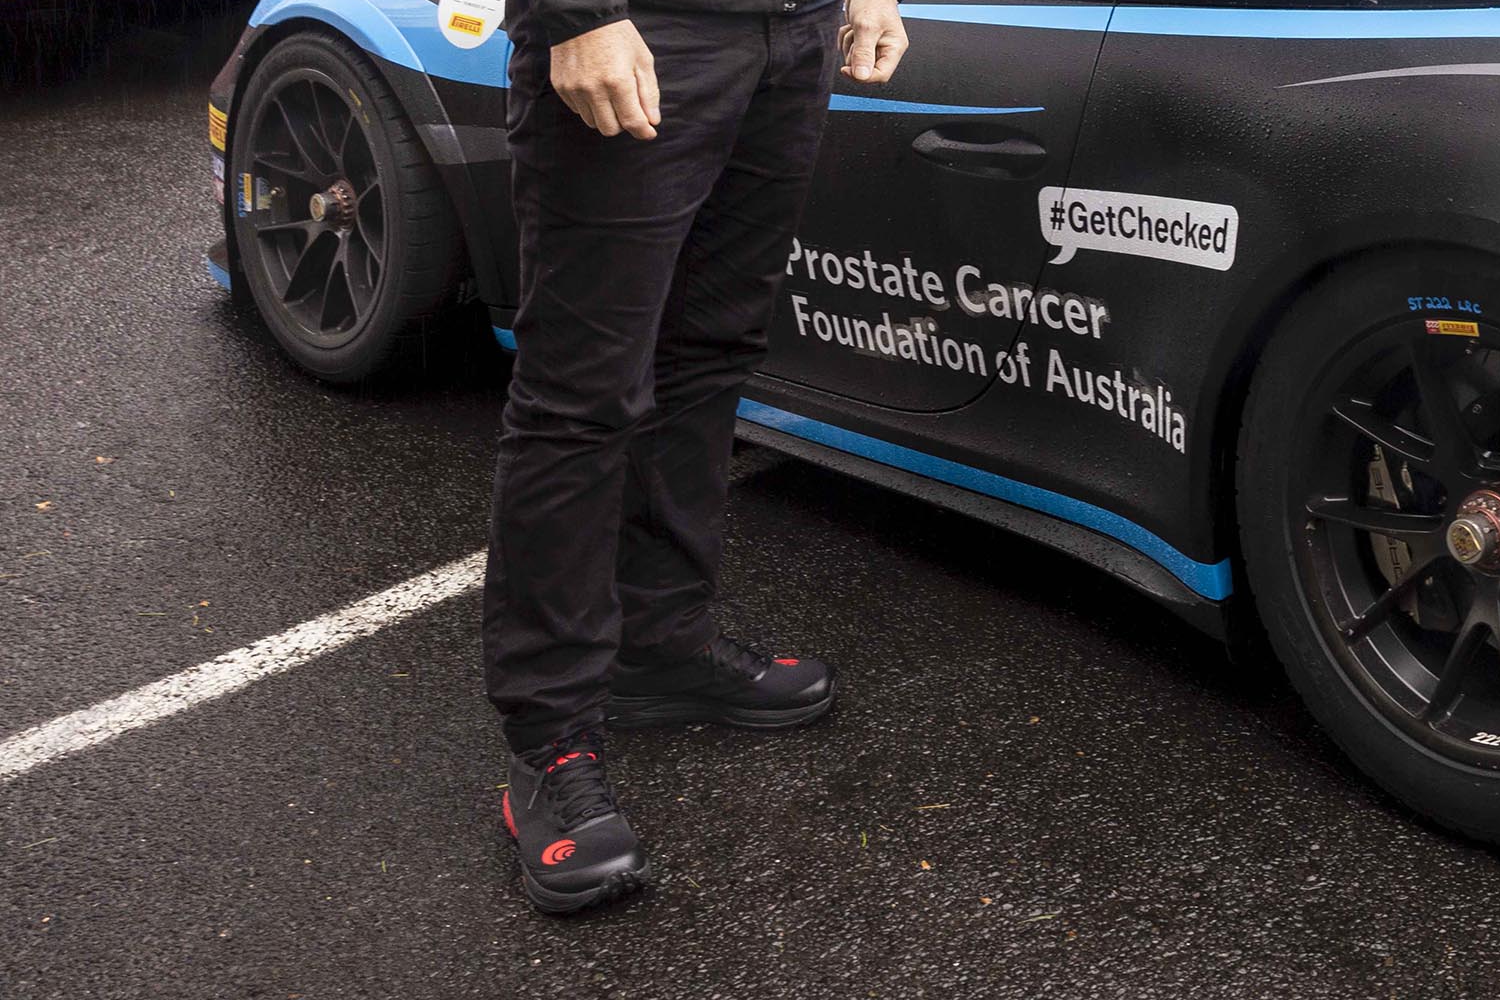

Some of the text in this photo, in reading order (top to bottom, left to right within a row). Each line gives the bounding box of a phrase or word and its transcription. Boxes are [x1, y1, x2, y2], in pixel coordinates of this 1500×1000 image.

[1050, 200, 1228, 254] #GetChecked
[786, 236, 1106, 339] Prostate Cancer
[1425, 296, 1453, 310] 222
[792, 295, 1186, 454] Foundation of Australia
